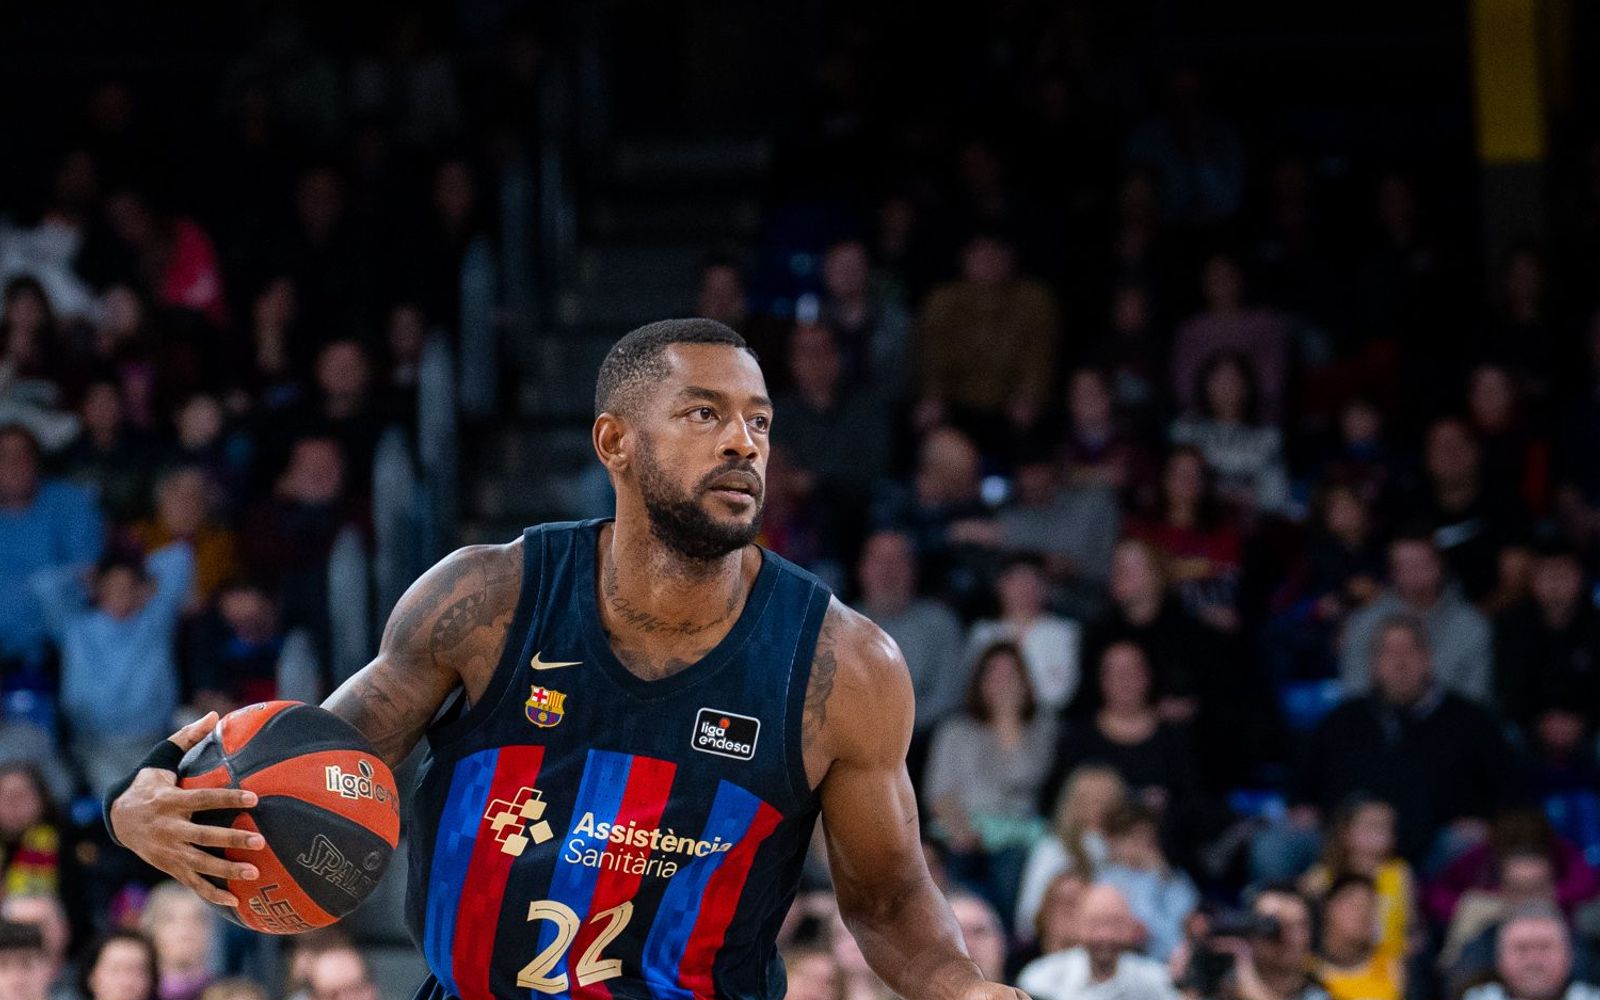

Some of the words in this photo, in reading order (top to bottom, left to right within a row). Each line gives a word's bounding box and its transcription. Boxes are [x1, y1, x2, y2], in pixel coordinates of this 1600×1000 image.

[698, 735, 751, 754] endesa
[701, 721, 726, 737] liga
[325, 765, 374, 800] liga
[565, 838, 678, 878] Sanitària
[516, 900, 634, 994] 22
